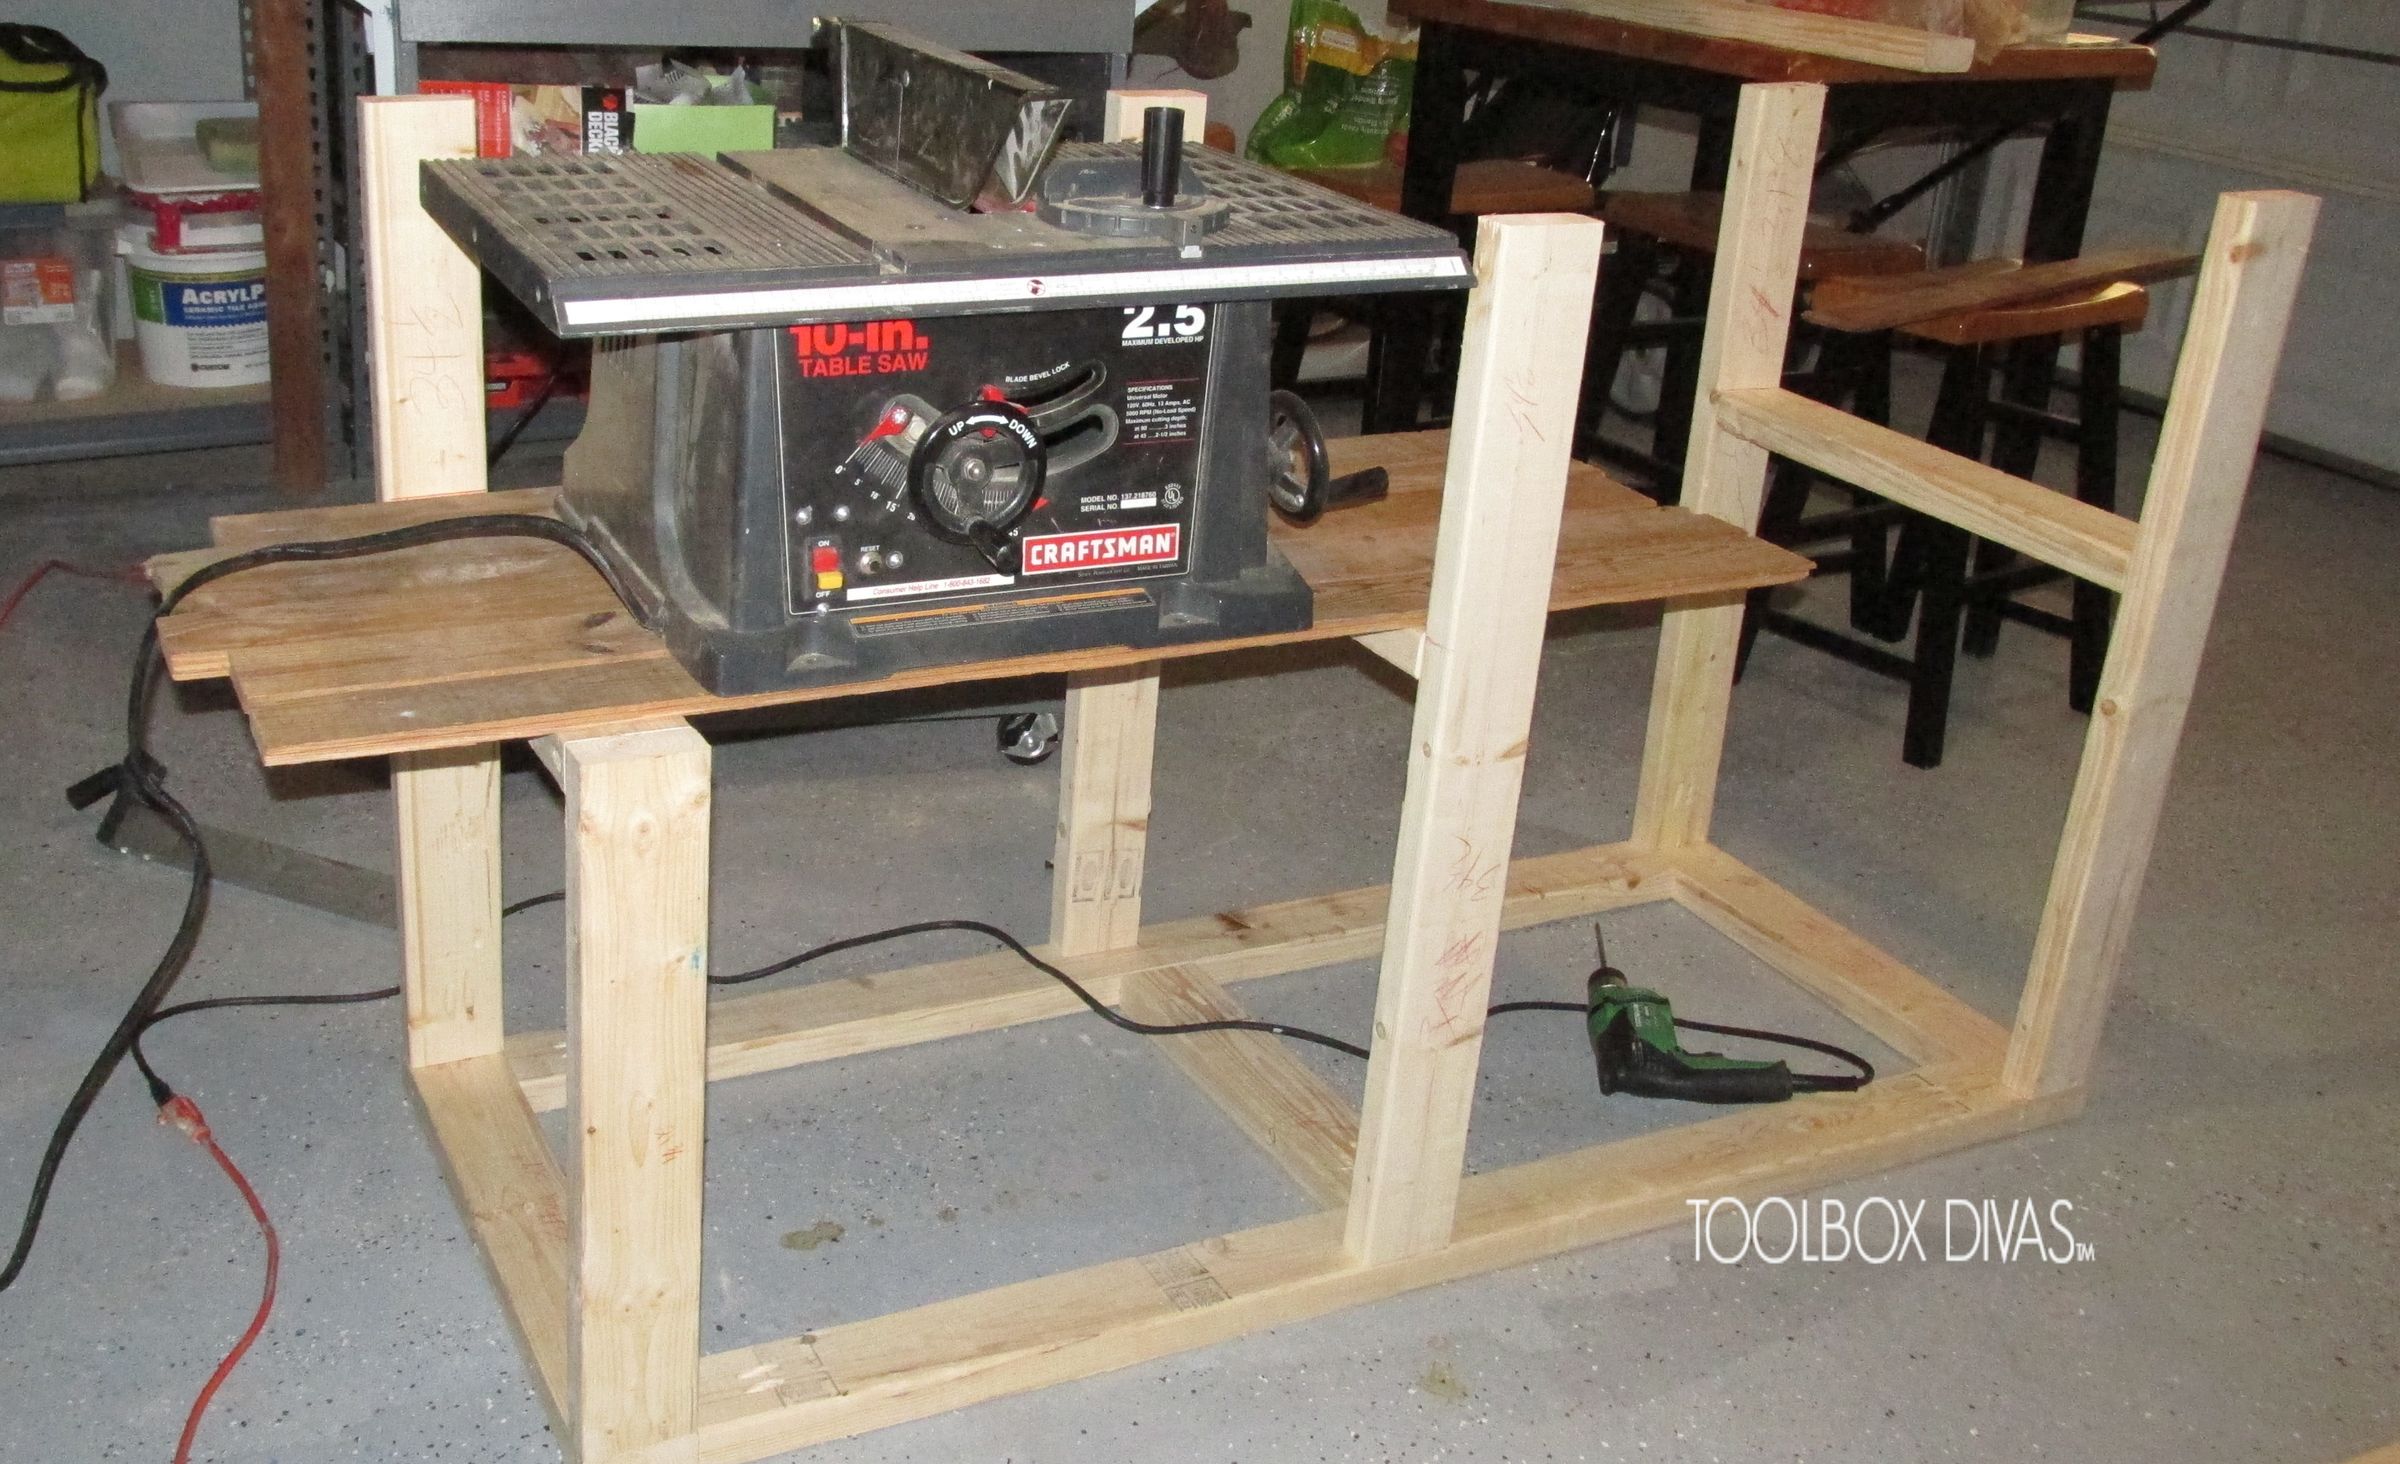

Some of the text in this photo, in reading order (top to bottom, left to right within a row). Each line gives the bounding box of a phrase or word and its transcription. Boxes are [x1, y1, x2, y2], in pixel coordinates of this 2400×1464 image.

[1122, 304, 1206, 339] 2.5
[1122, 335, 1205, 347] MAXIMUM DEVELOPED HP
[799, 352, 929, 378] TABLE SAW
[1005, 361, 1071, 384] BLADE BEVEL LOCK
[948, 418, 1038, 449] UP DOWN
[1080, 495, 1105, 504] MODEL
[1106, 493, 1120, 501] NO.
[1080, 502, 1120, 513] SERIAL NO.
[860, 544, 880, 552] RESET
[1031, 532, 1171, 566] CRAFTSMAN
[872, 584, 907, 595] Consumer
[908, 582, 924, 593] Help
[924, 581, 939, 590] Line
